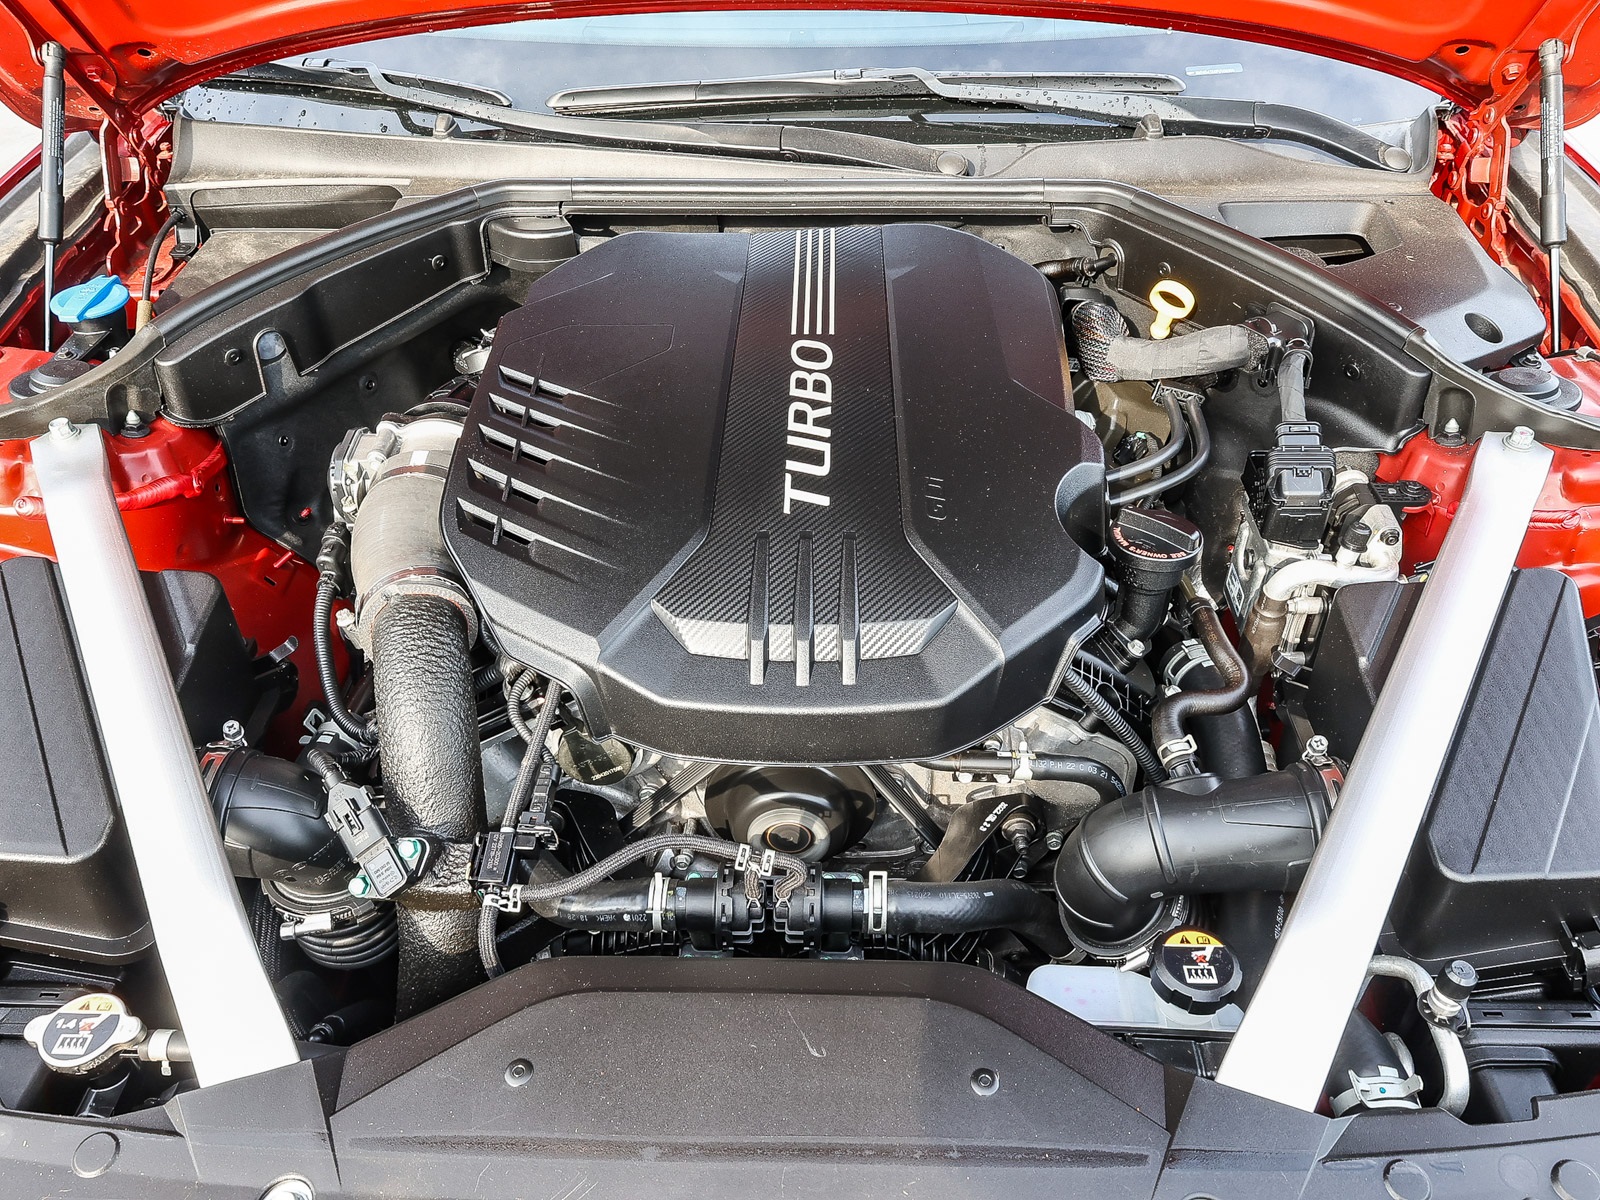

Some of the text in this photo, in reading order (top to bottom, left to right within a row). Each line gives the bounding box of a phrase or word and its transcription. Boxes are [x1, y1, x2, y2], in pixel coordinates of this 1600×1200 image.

[783, 339, 833, 514] TURBO
[1128, 546, 1168, 559] OWNER'S
[1066, 762, 1076, 770] 22
[1087, 765, 1098, 775] 03
[1099, 770, 1109, 779] 21
[56, 1018, 77, 1030] 1.4
